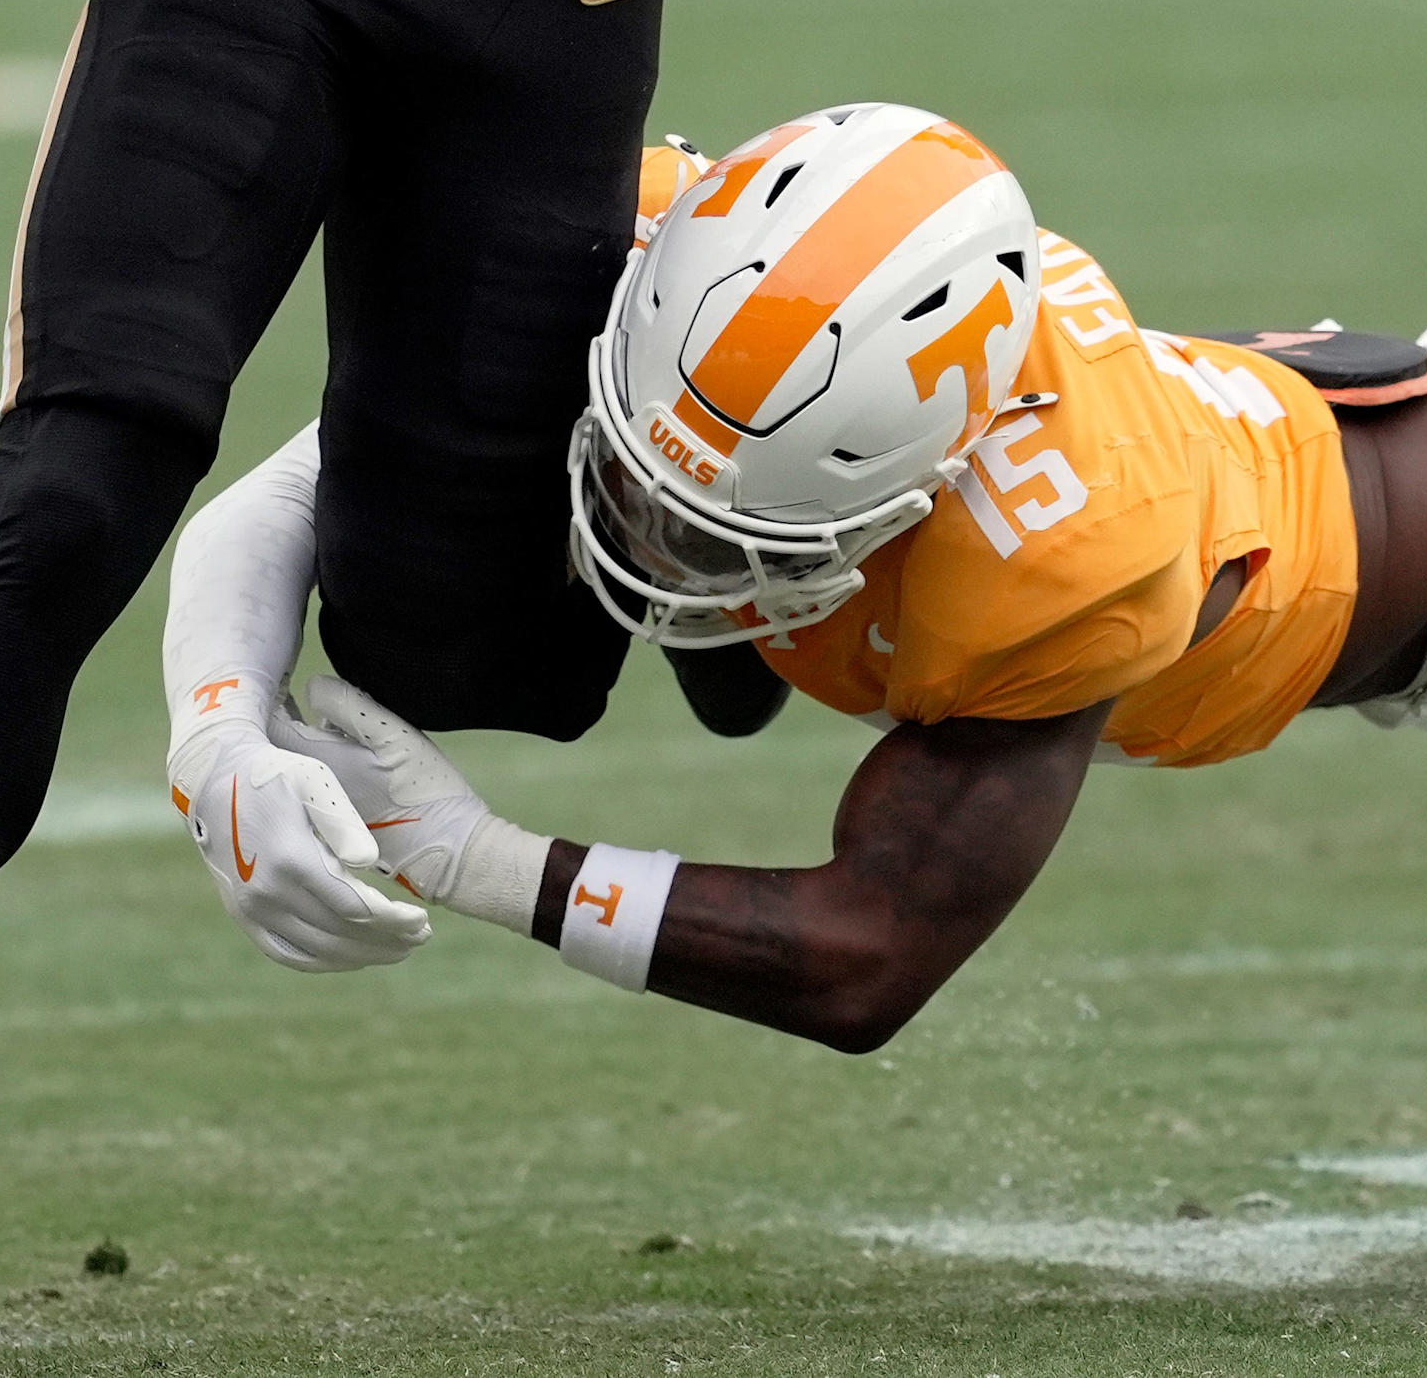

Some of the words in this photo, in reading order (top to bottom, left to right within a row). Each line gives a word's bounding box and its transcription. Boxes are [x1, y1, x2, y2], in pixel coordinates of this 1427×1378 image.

[906, 277, 1014, 461] T
[650, 418, 720, 486] VOLS
[946, 412, 1088, 560] 15
[194, 679, 239, 715] T
[574, 884, 623, 926] T
